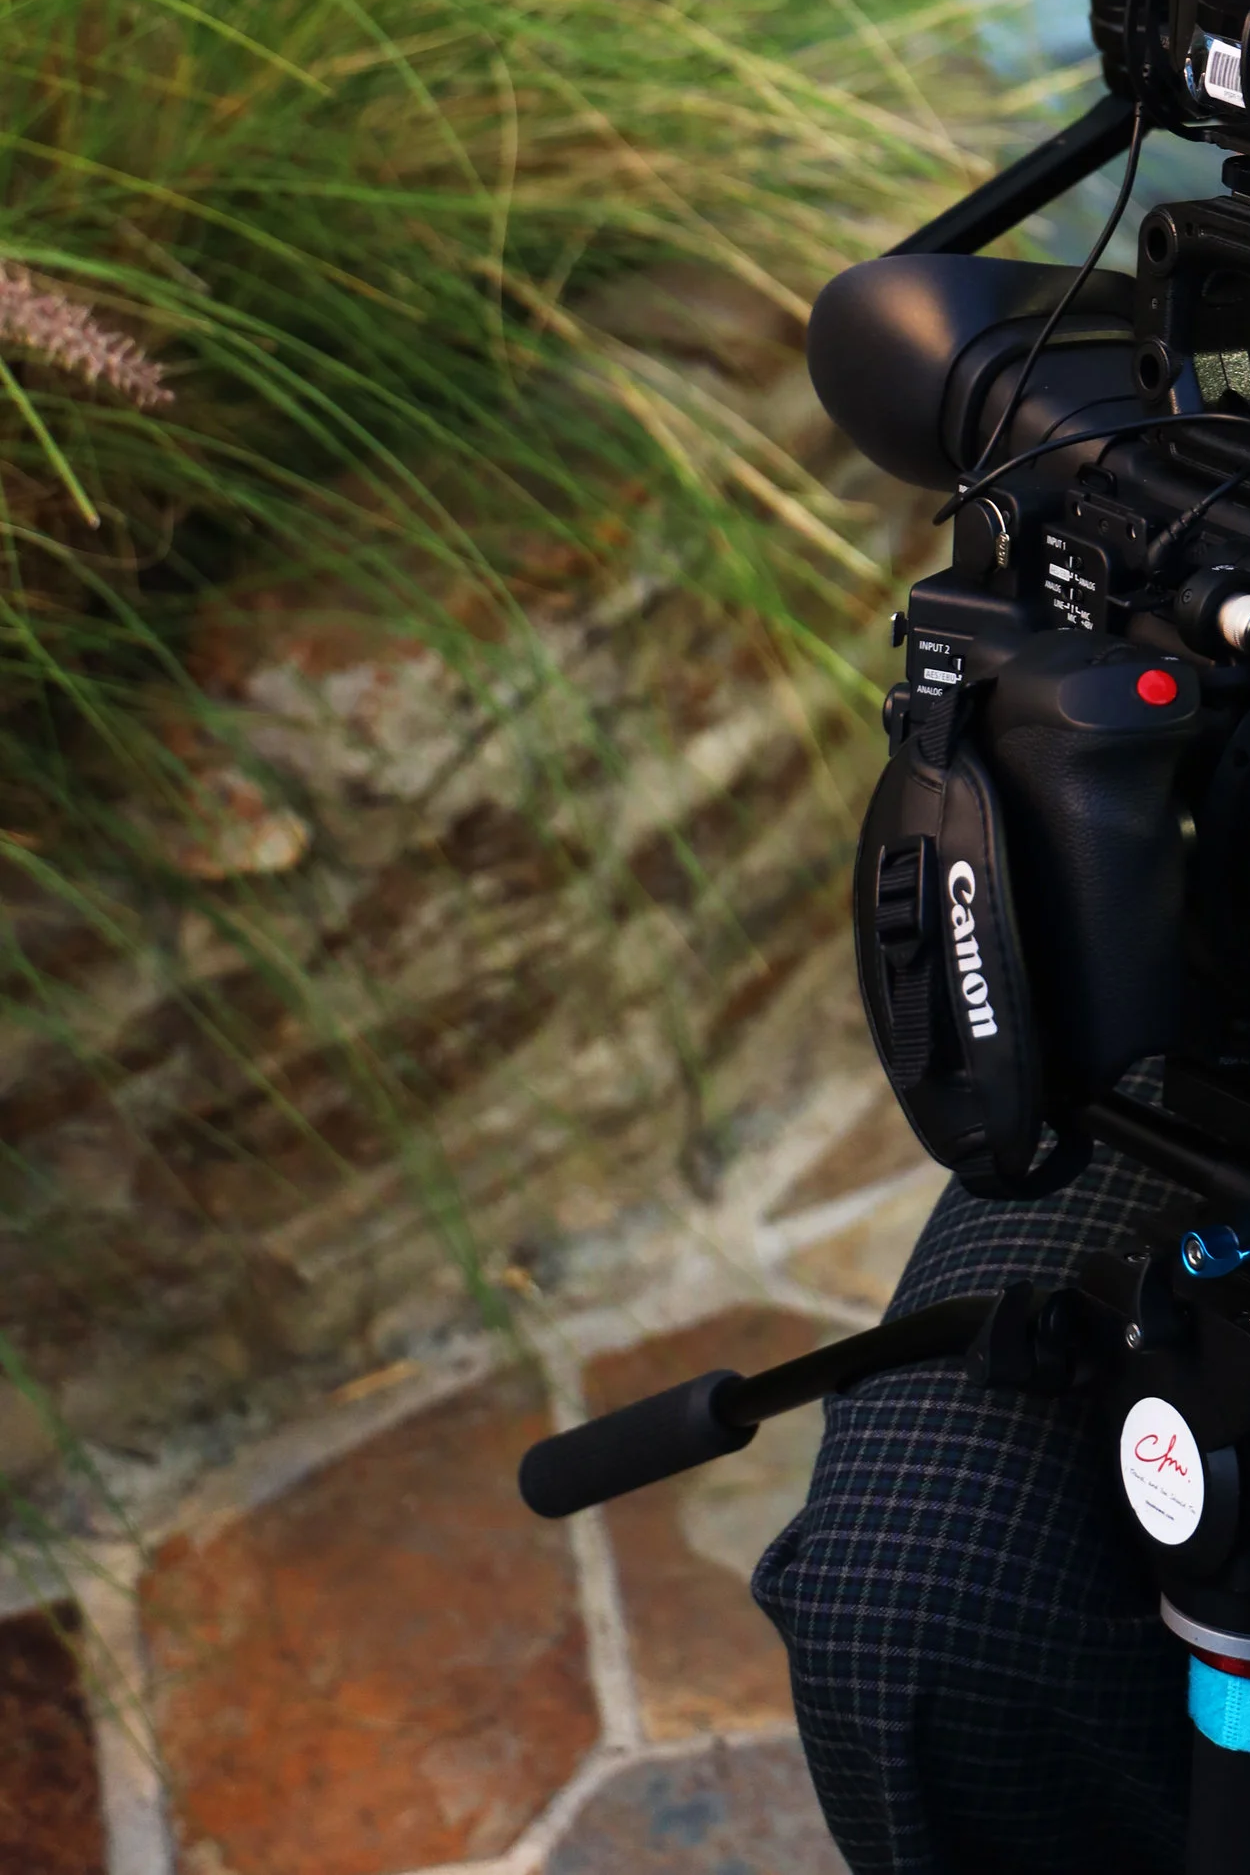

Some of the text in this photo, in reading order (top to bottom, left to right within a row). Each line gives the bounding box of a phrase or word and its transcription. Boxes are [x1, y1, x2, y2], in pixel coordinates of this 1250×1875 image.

[918, 640, 951, 655] INPUT 2
[916, 685, 943, 697] ANALOG
[946, 858, 998, 1041] Canon
